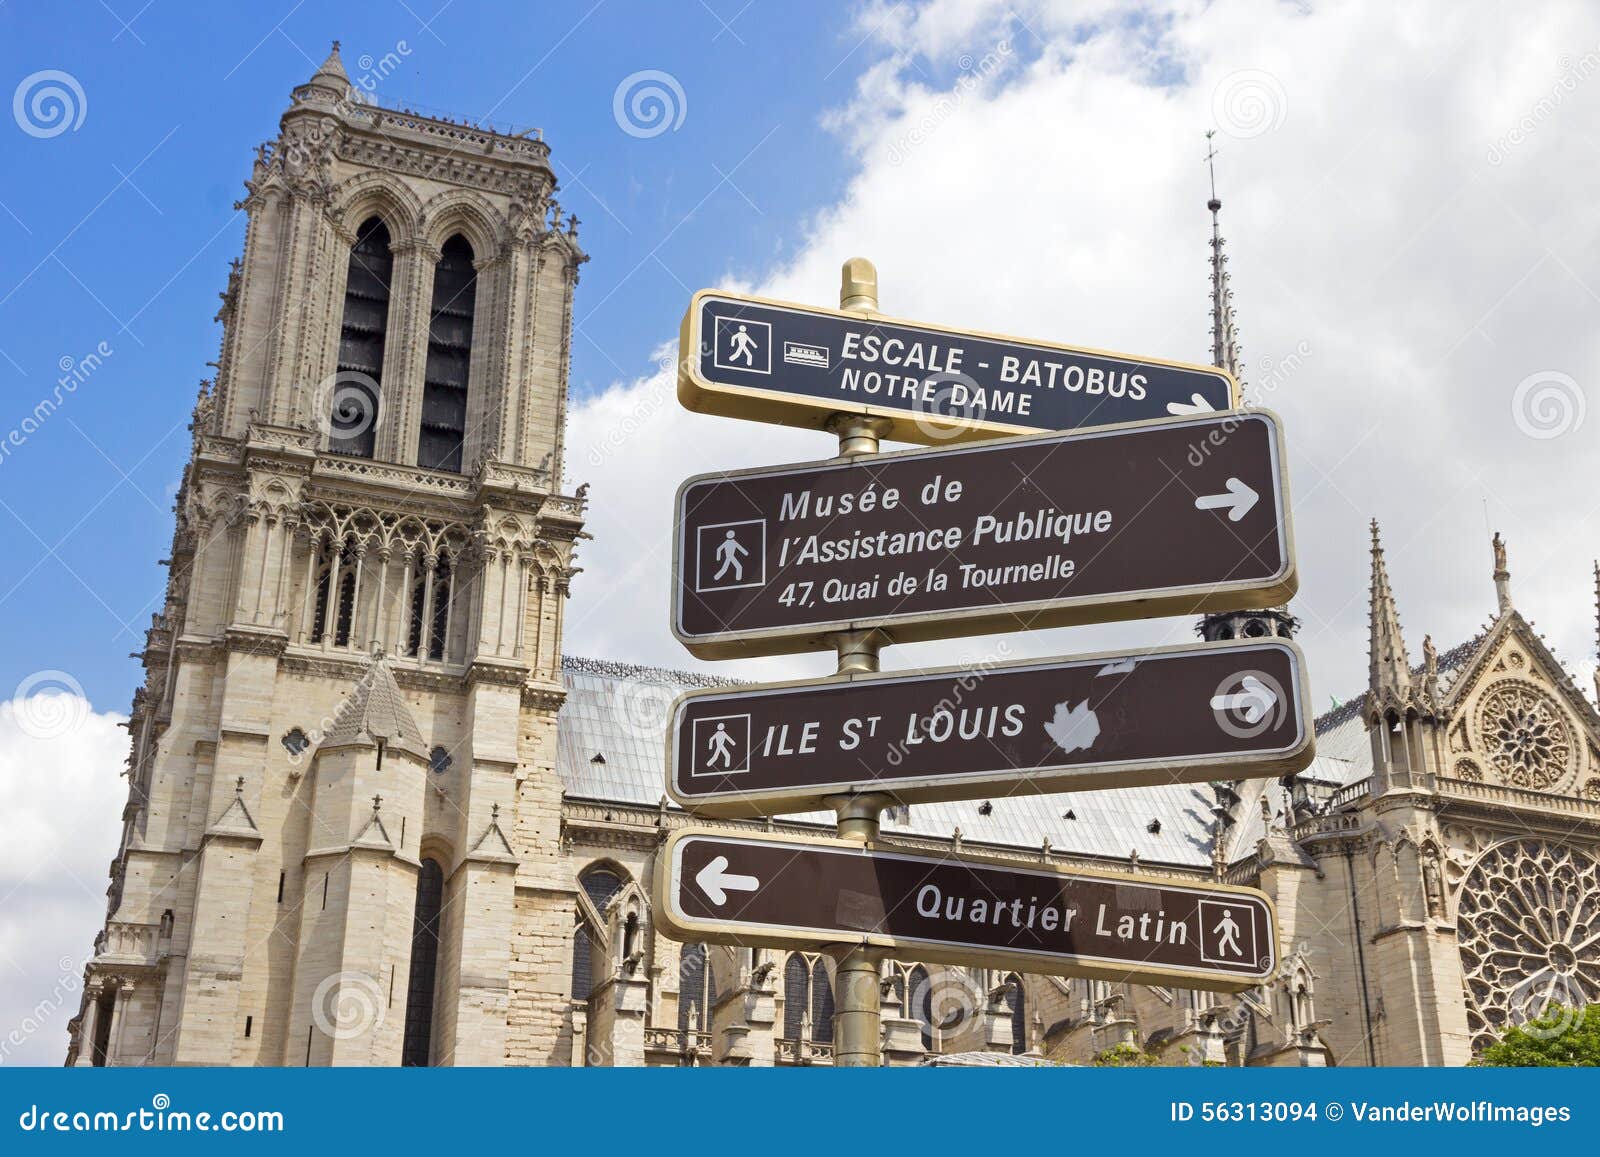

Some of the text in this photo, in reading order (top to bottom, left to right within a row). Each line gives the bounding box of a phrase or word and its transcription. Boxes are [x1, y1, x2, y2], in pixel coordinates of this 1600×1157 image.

[842, 332, 964, 374] ESCALE
[1000, 356, 1148, 400] BATOBUS
[841, 369, 1032, 416] NOTRE DAME
[779, 475, 963, 521] Musée de
[973, 508, 1112, 546] Publique
[822, 574, 879, 603] Quai
[887, 571, 917, 597] de
[925, 568, 948, 593] la
[959, 554, 1075, 589] Tournelle
[763, 722, 820, 757] ILE
[906, 704, 1025, 745] LOUIS
[916, 884, 1187, 945] Quartier Latin
